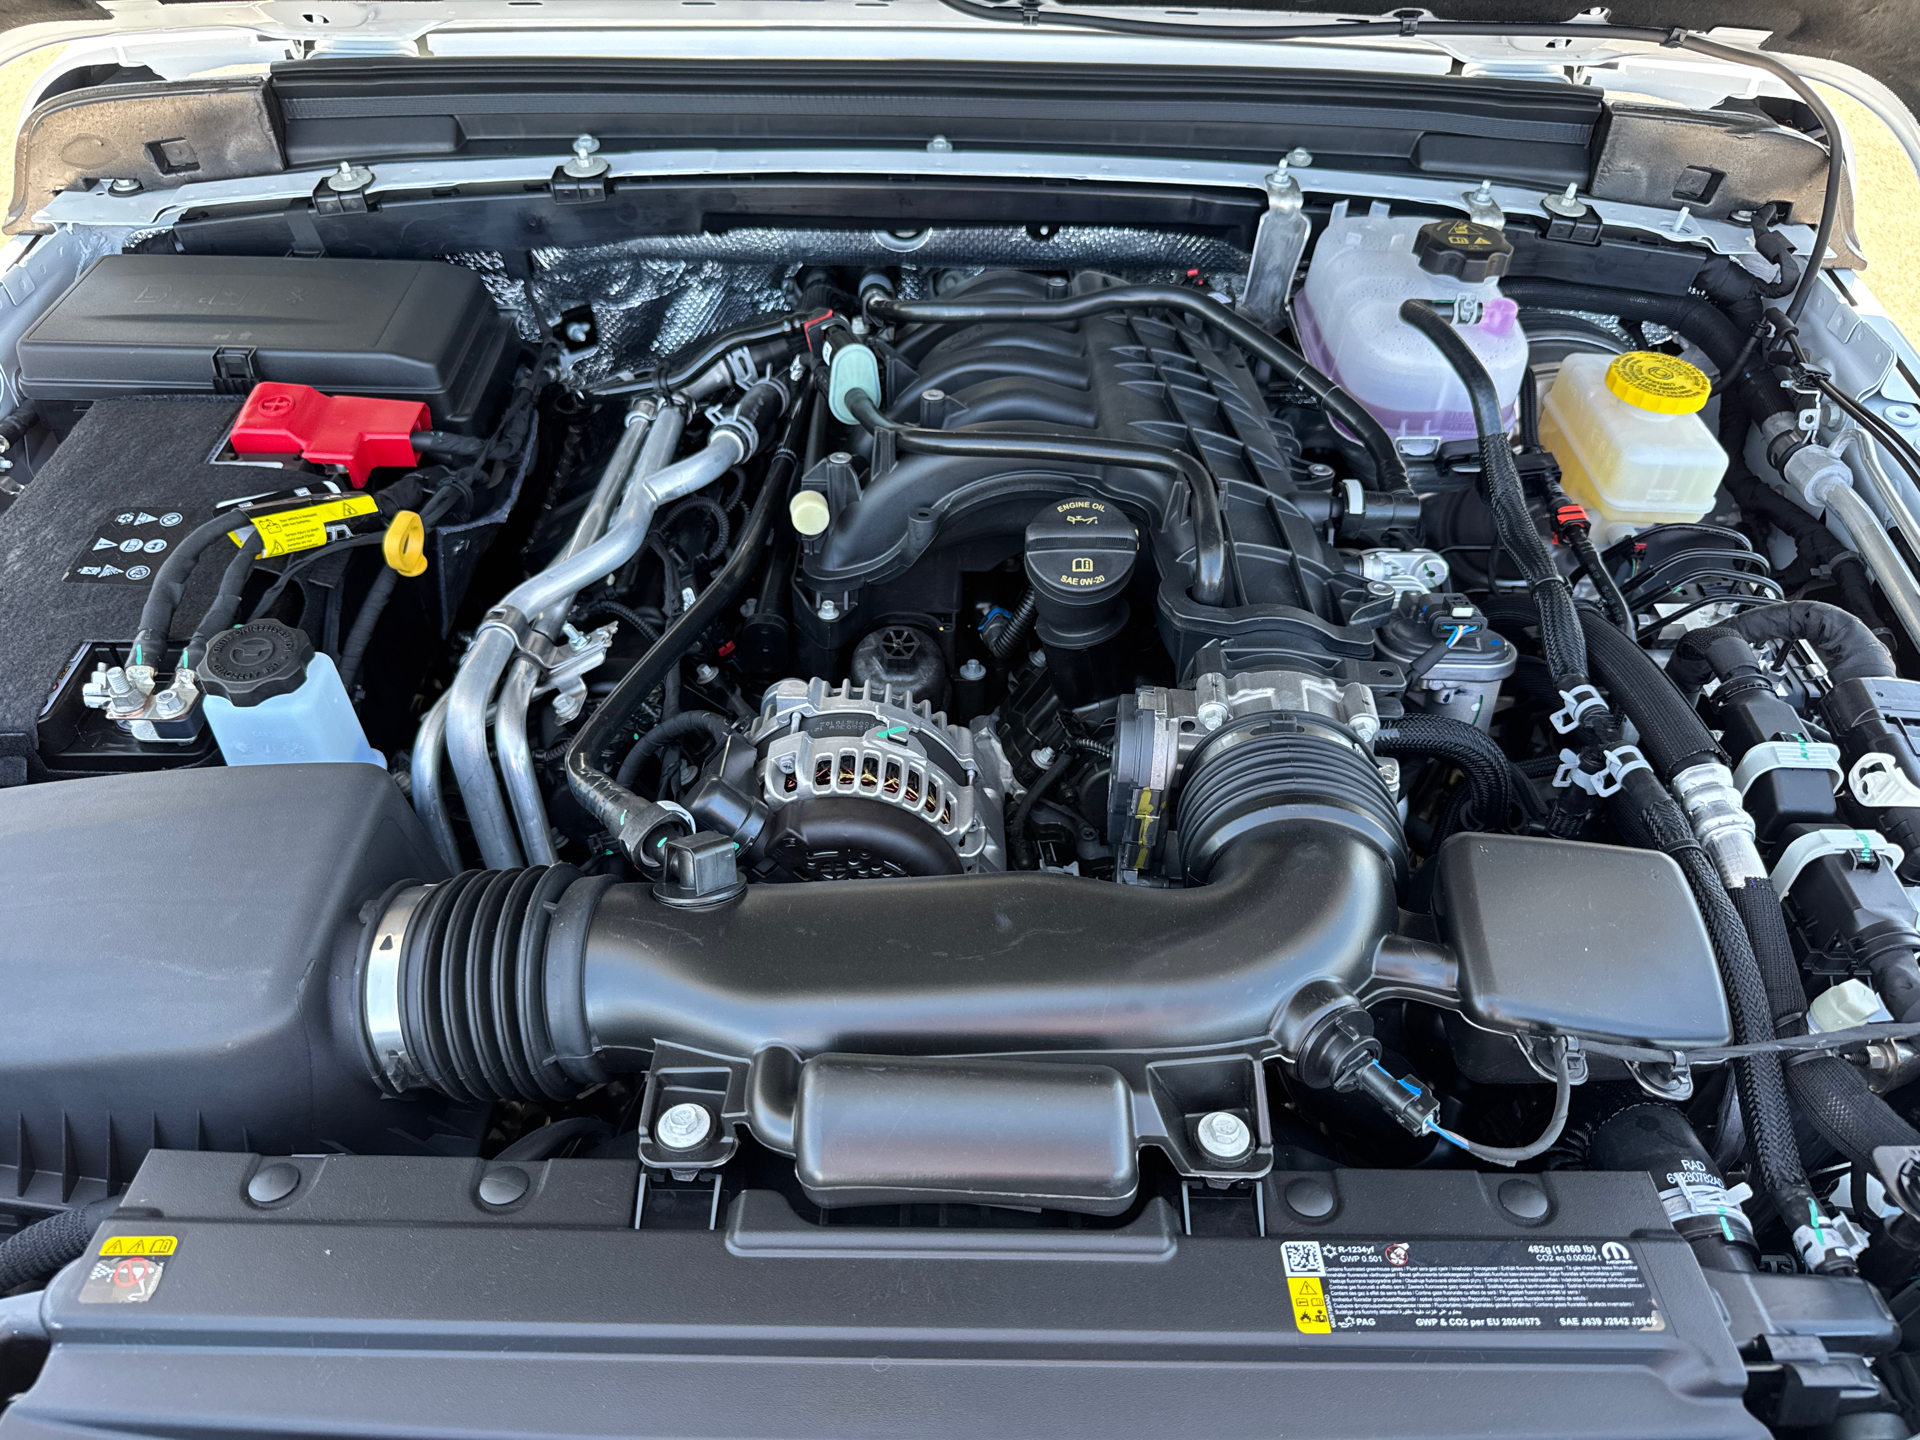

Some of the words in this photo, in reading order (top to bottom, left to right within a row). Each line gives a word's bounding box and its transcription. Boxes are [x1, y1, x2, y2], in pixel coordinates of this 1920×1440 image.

[1056, 502, 1090, 512] ENGINE
[1092, 503, 1106, 512] OIL
[1060, 574, 1078, 585] SAE
[1080, 574, 1105, 586] 0W-20
[233, 624, 280, 636] STEERING
[212, 634, 232, 654] FLUID
[212, 663, 260, 680] APPROVED
[262, 662, 280, 674] USE
[1680, 1160, 1706, 1172] RAD
[1666, 1172, 1724, 1188] 6280782AD
[1338, 1246, 1375, 1254] R-1234yf
[1528, 1244, 1551, 1254] 482g
[1552, 1244, 1581, 1254] (1.060
[1582, 1244, 1597, 1254] lb)
[1356, 1318, 1376, 1326] PAG
[1415, 1318, 1437, 1326] GWP
[1440, 1318, 1447, 1326] &
[1448, 1318, 1468, 1326] CO2
[1486, 1318, 1500, 1326] EU
[1501, 1318, 1541, 1326] 2024/573
[1559, 1318, 1579, 1326] SAE
[1581, 1318, 1602, 1326] J639
[1604, 1318, 1630, 1326] J2842
[1631, 1318, 1657, 1326] J2845
